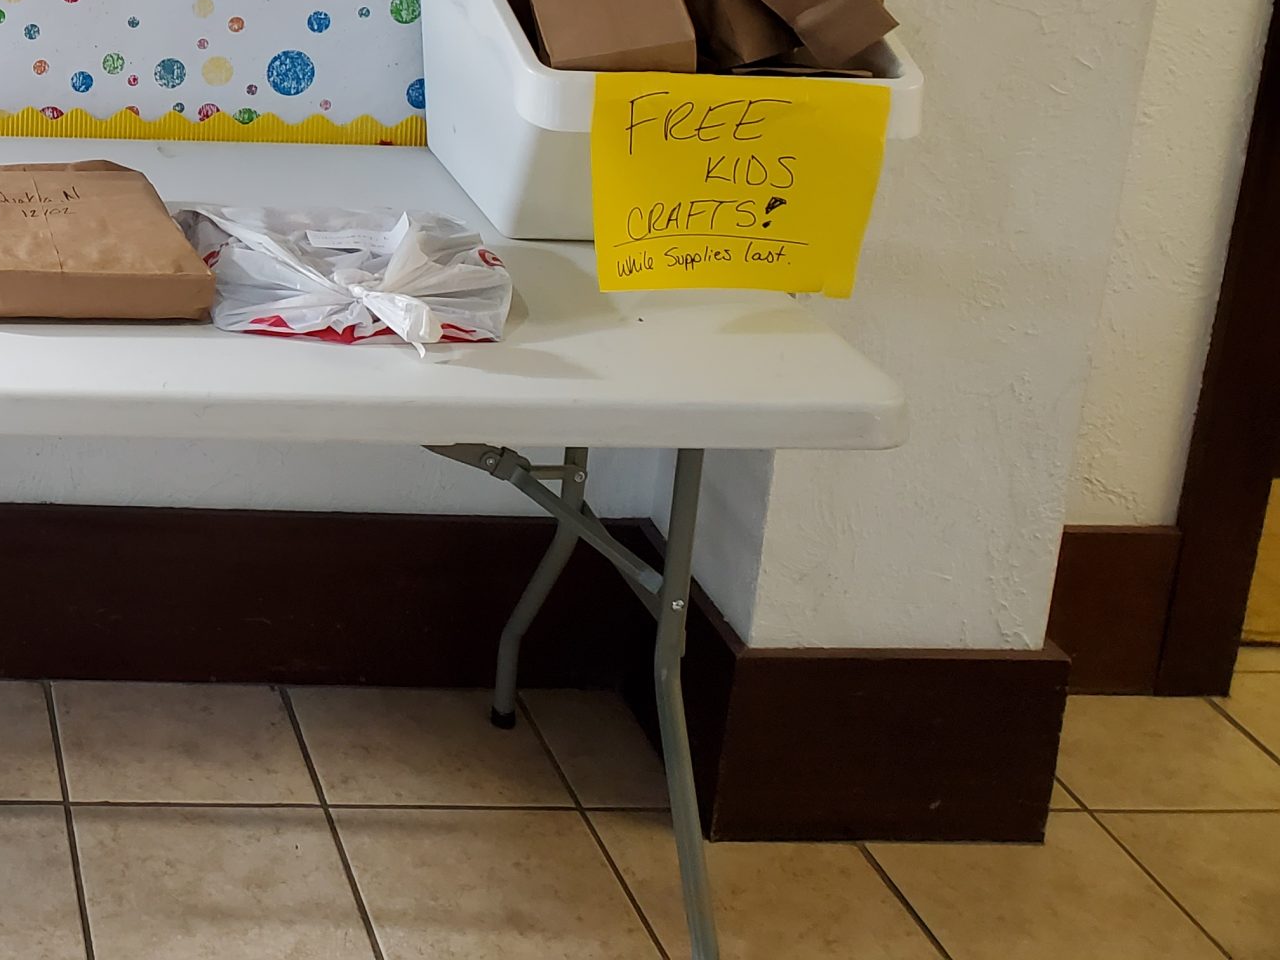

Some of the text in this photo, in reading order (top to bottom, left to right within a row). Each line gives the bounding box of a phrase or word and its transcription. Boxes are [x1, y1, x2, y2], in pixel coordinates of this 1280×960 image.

[625, 91, 792, 156] FREE
[704, 155, 796, 189] KIDS
[626, 196, 788, 242] CRAFTS!
